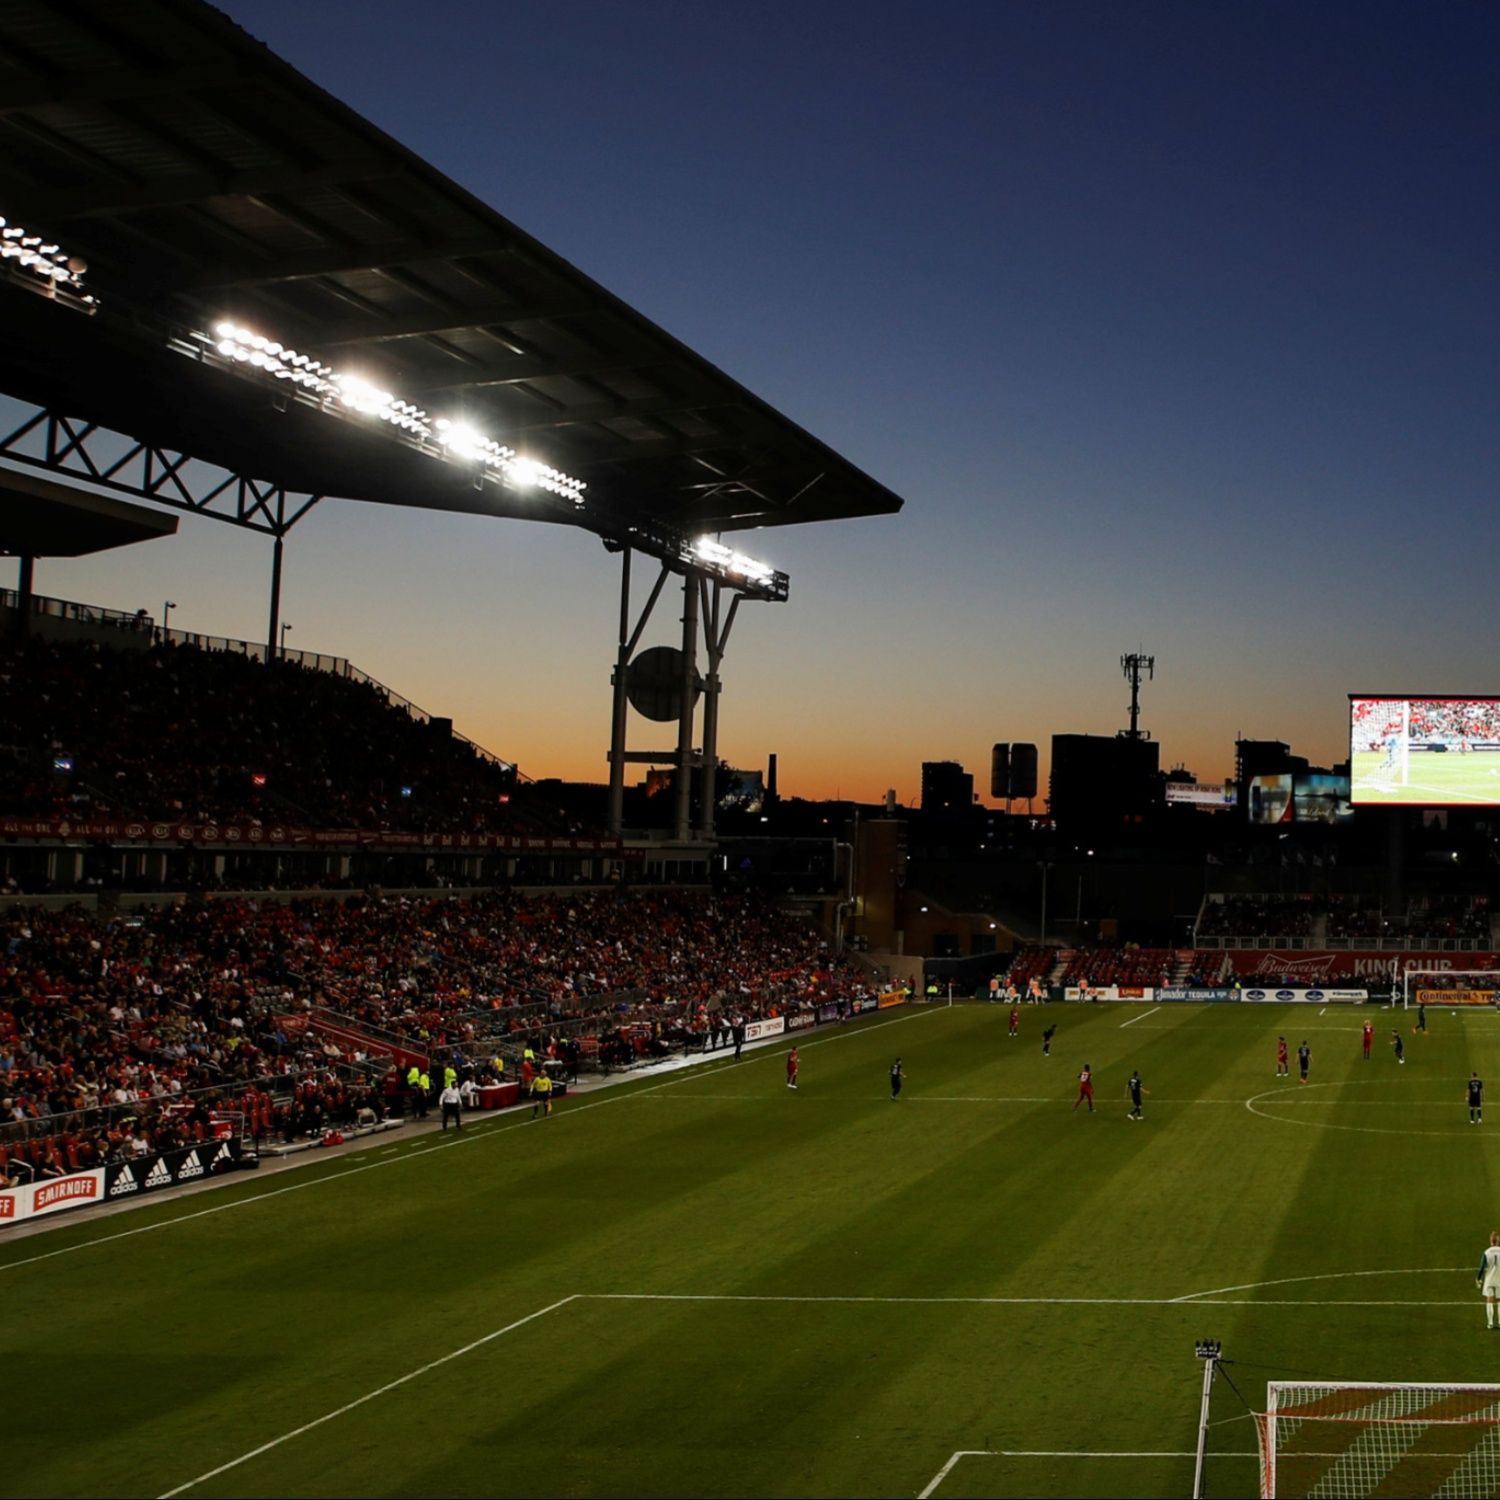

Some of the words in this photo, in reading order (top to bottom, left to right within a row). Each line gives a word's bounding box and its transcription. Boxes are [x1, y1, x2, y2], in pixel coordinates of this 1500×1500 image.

[1257, 956, 1331, 975] Budweiser
[178, 1164, 204, 1180] adidas
[110, 1181, 139, 1196] adidas
[144, 1174, 173, 1188] adidas
[38, 1179, 93, 1207] SMIRNOFF
